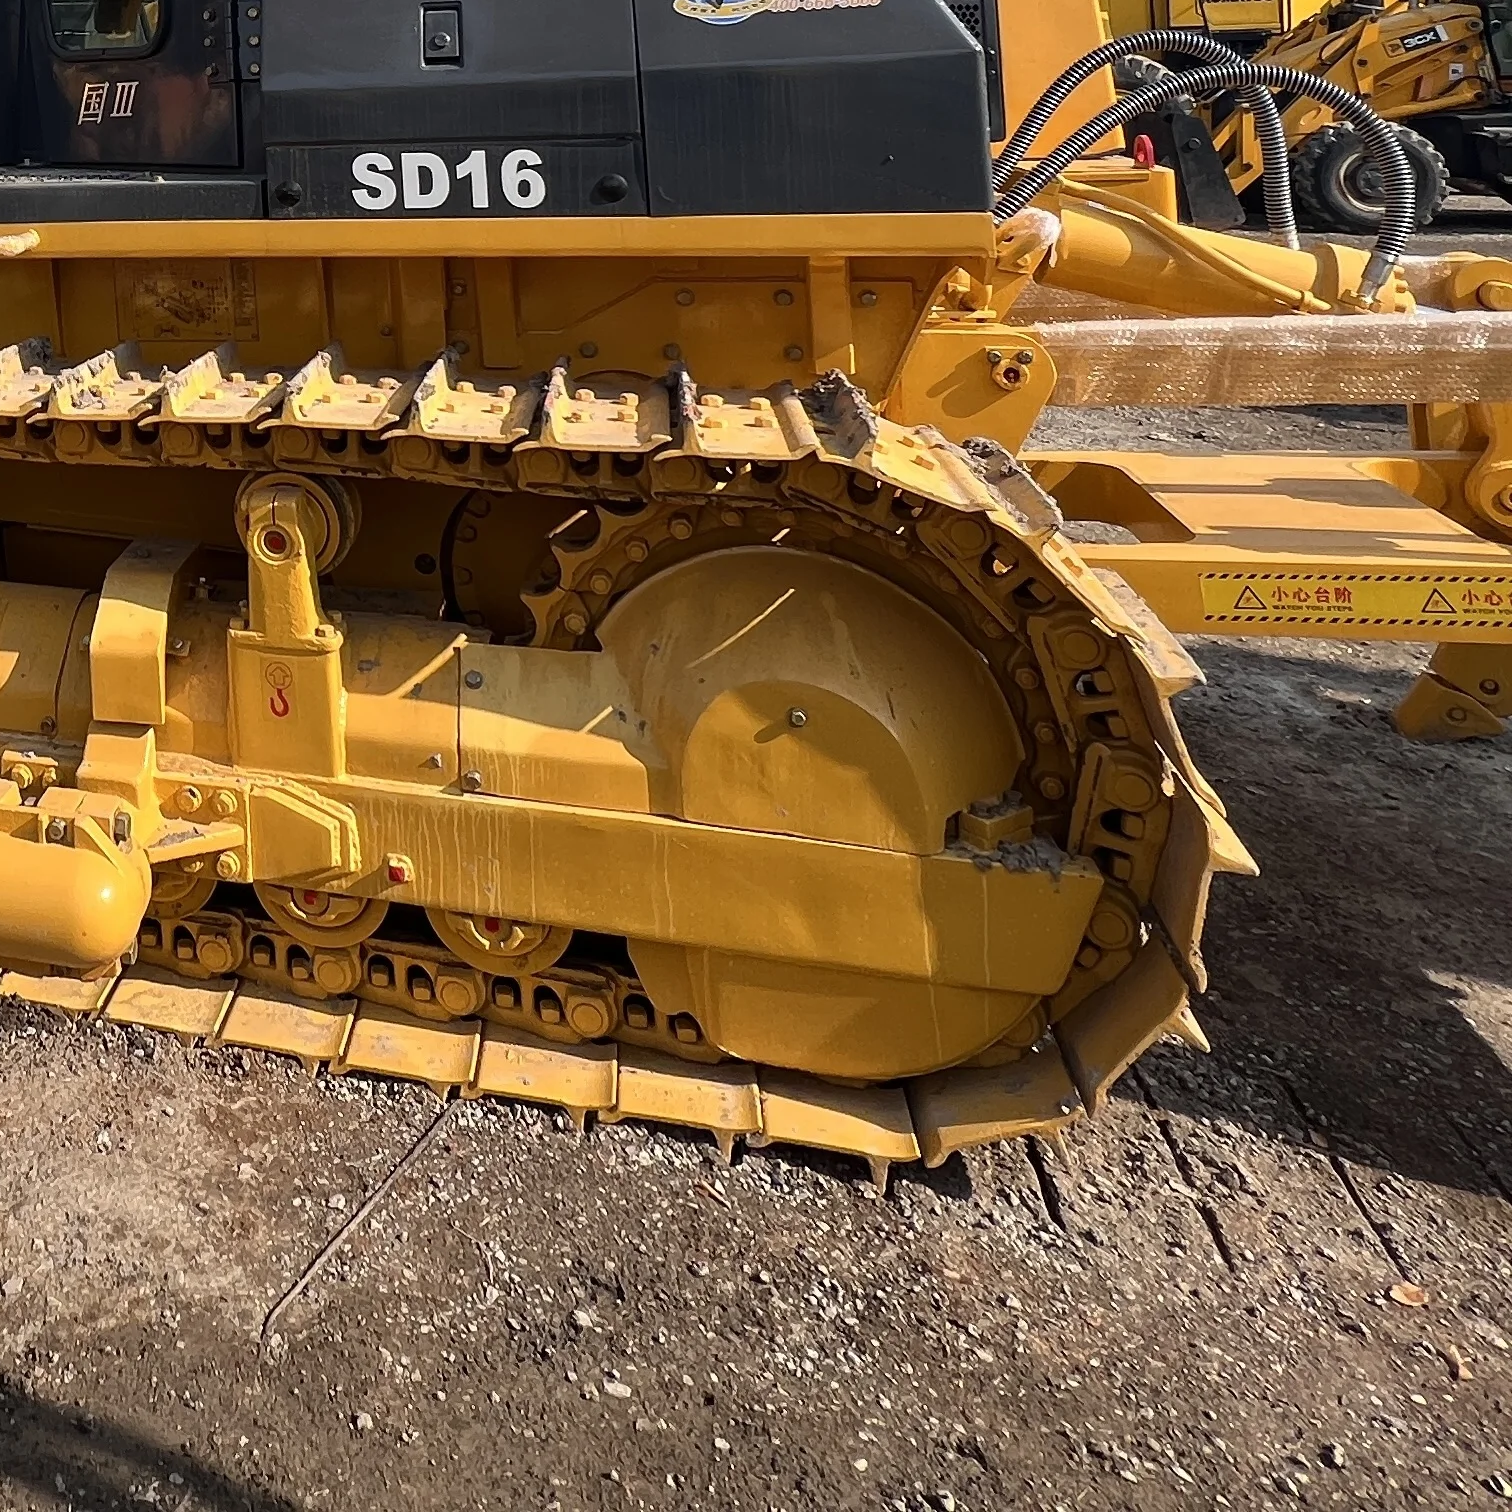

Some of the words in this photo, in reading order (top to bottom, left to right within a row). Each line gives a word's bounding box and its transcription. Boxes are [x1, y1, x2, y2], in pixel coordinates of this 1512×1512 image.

[1403, 31, 1437, 48] 3CX
[352, 149, 546, 210] SD16
[1271, 586, 1352, 603] 小心台阶
[1461, 589, 1512, 606] 小心
